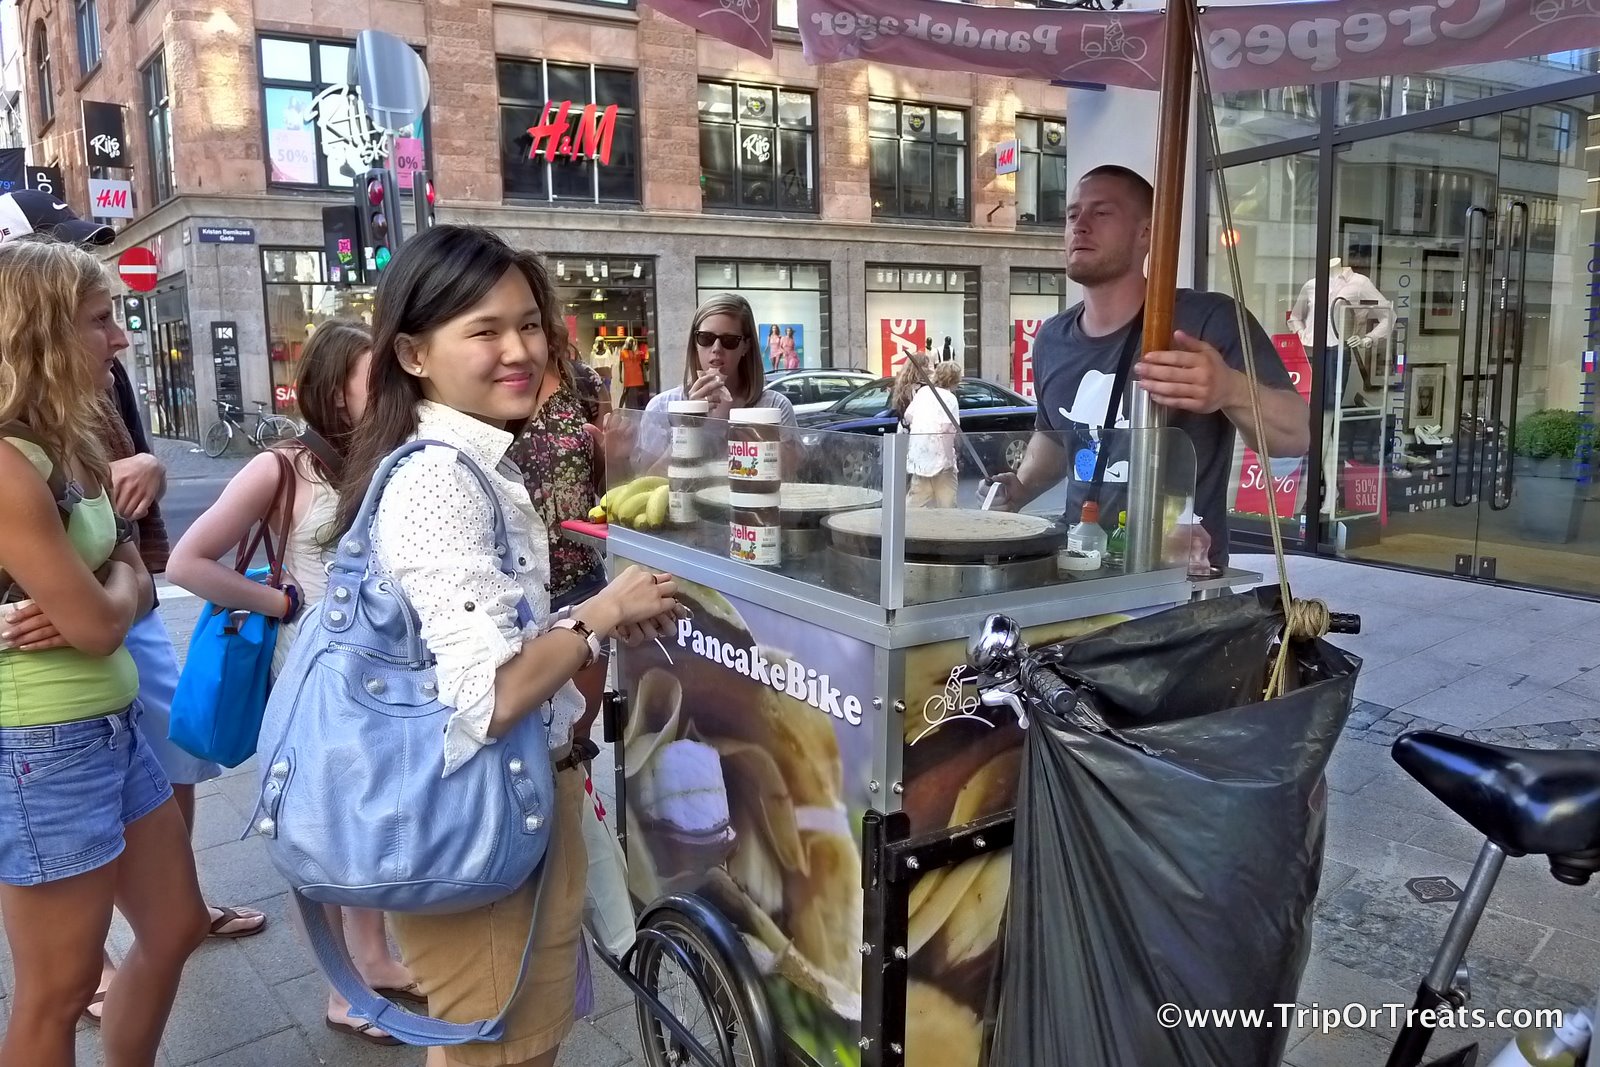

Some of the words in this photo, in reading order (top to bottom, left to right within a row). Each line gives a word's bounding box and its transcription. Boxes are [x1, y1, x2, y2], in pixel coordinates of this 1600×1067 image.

[527, 98, 619, 167] H&M
[89, 134, 121, 156] Riis
[277, 148, 310, 164] 50%
[397, 155, 418, 170] 0%
[998, 147, 1014, 167] H&M
[96, 188, 127, 209] H&M
[728, 441, 758, 457] utella
[1355, 479, 1377, 493] 50%
[1355, 493, 1378, 506] SALE
[676, 616, 863, 727] PancakeBike
